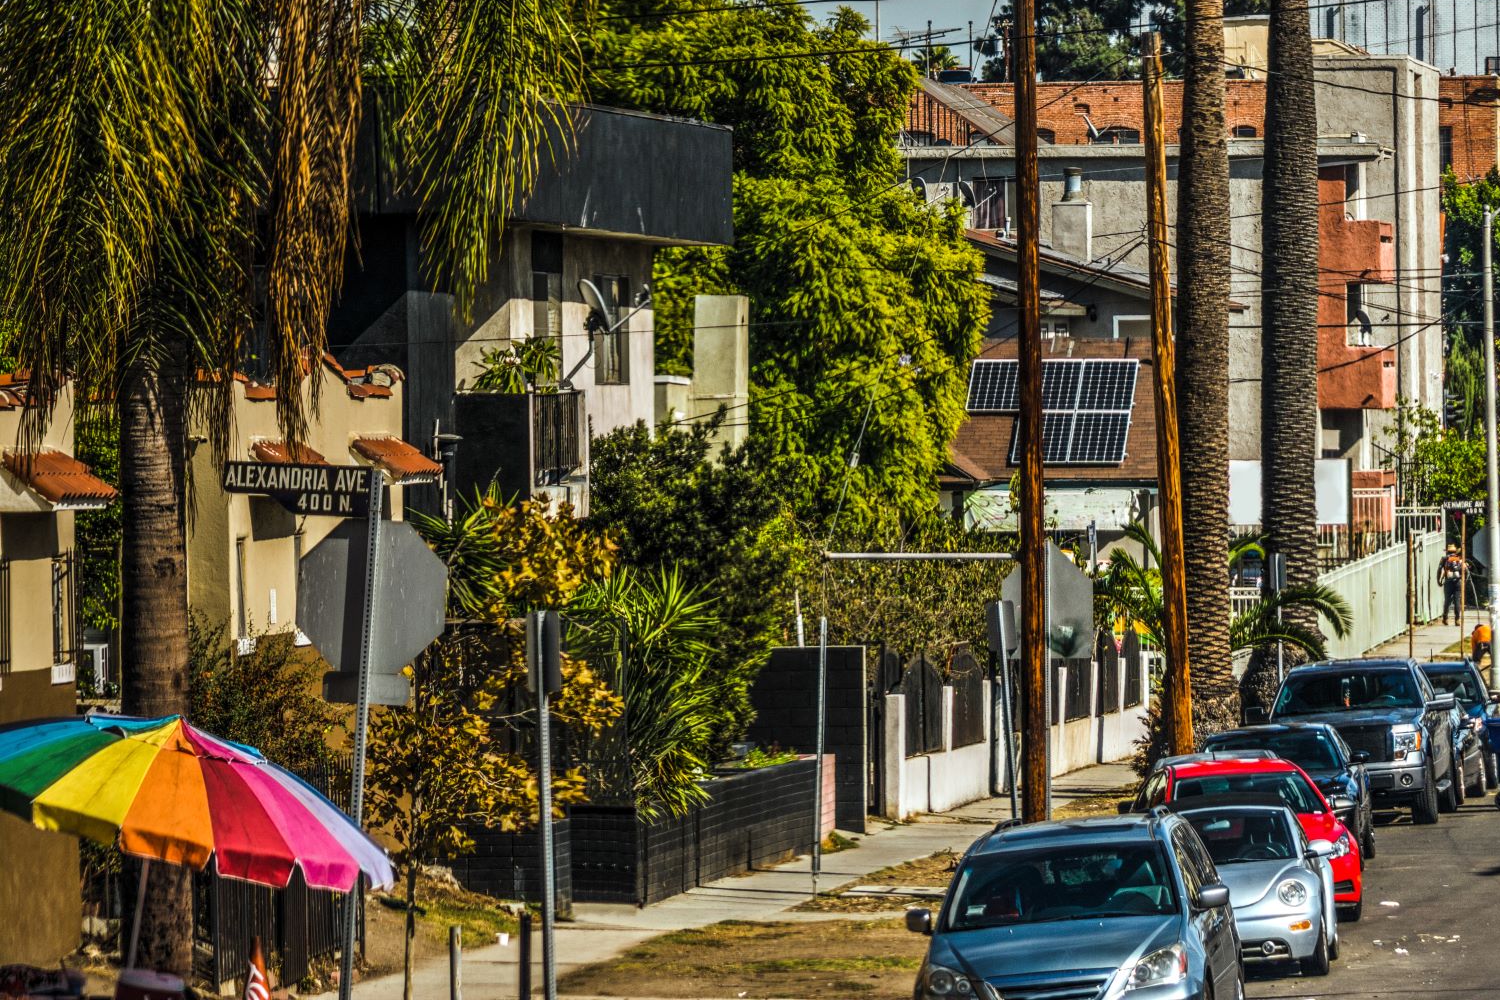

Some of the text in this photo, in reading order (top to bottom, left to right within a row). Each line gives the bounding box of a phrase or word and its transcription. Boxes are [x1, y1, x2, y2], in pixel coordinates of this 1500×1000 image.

[225, 464, 369, 493] ALEXANDRIA AVE.
[297, 493, 353, 512] 400 N.
[1443, 500, 1473, 509] KENMORE
